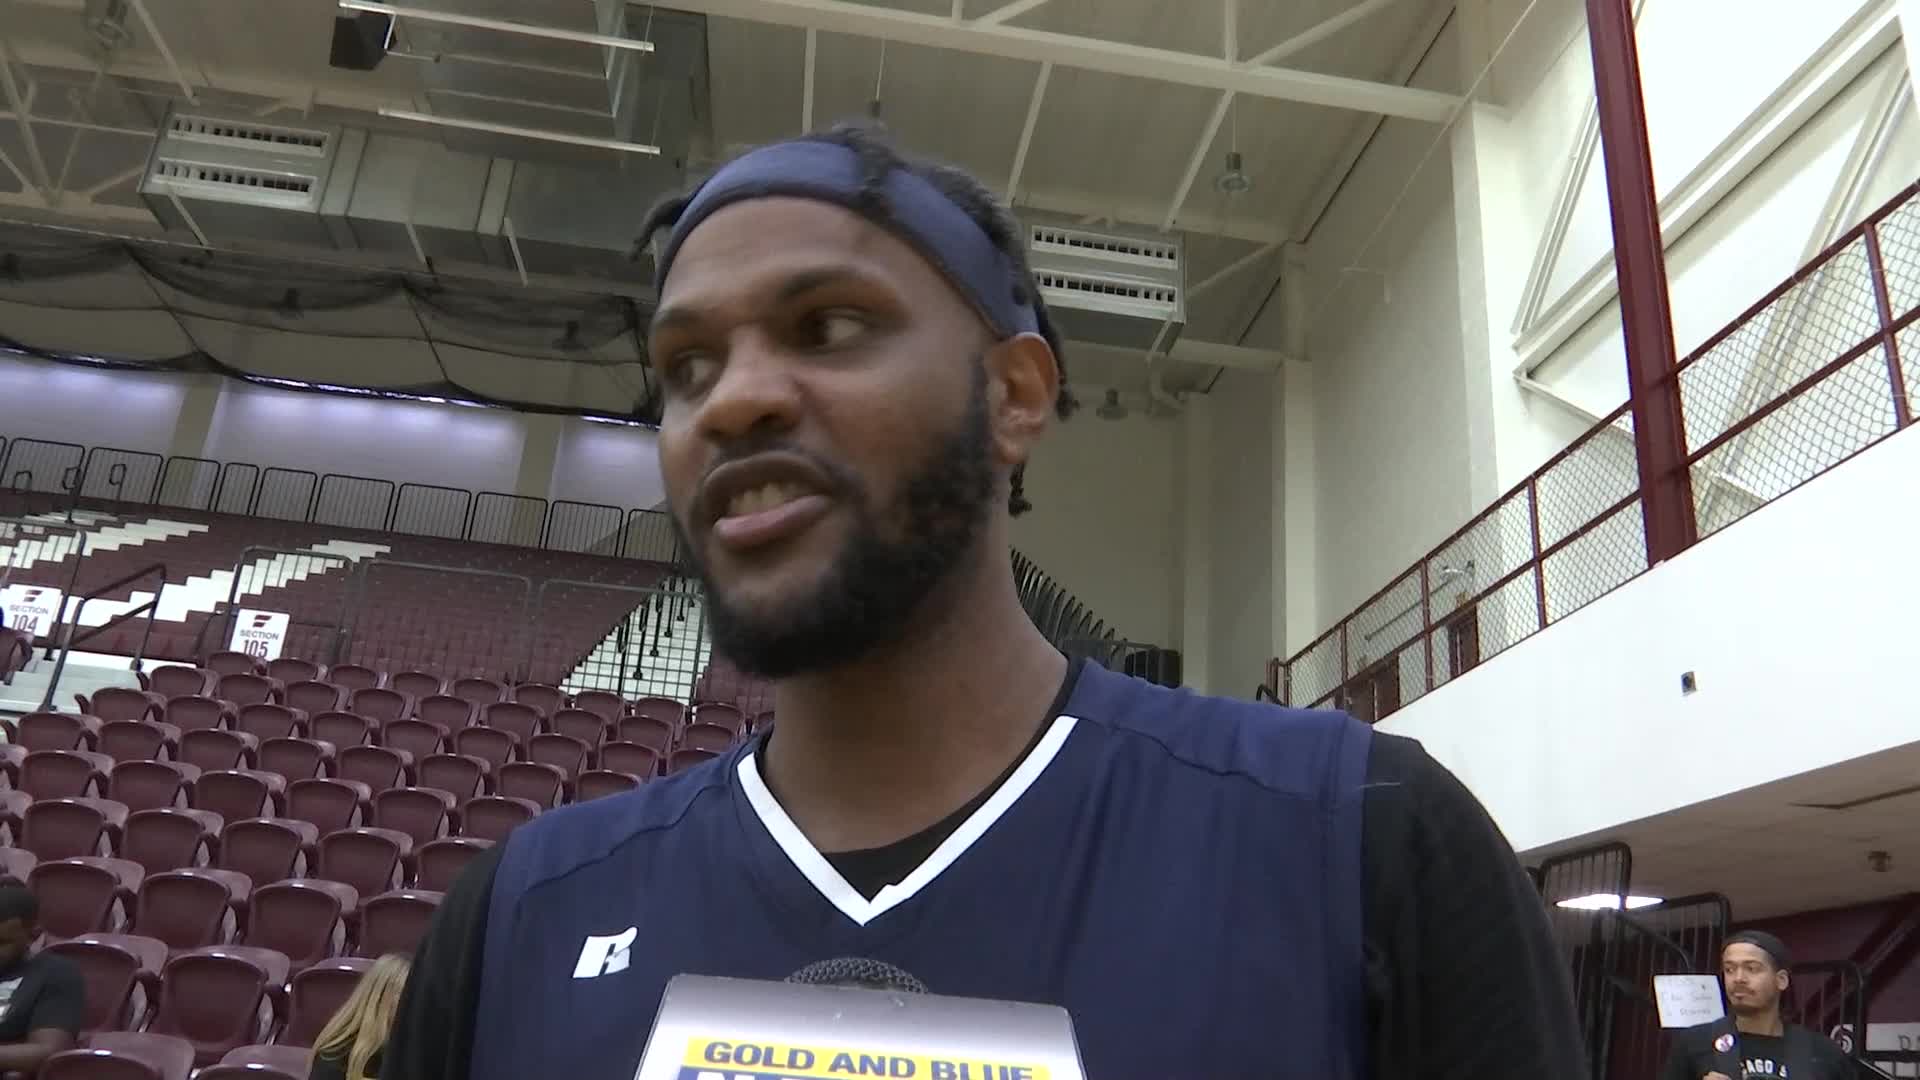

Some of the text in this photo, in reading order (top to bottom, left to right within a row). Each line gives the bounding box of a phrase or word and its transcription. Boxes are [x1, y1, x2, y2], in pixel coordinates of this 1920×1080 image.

[10, 604, 48, 615] SECTION
[12, 614, 38, 631] 104
[240, 630, 279, 640] SECTION
[243, 639, 268, 657] 105
[704, 1041, 1033, 1080] GOLD AND BLUE
